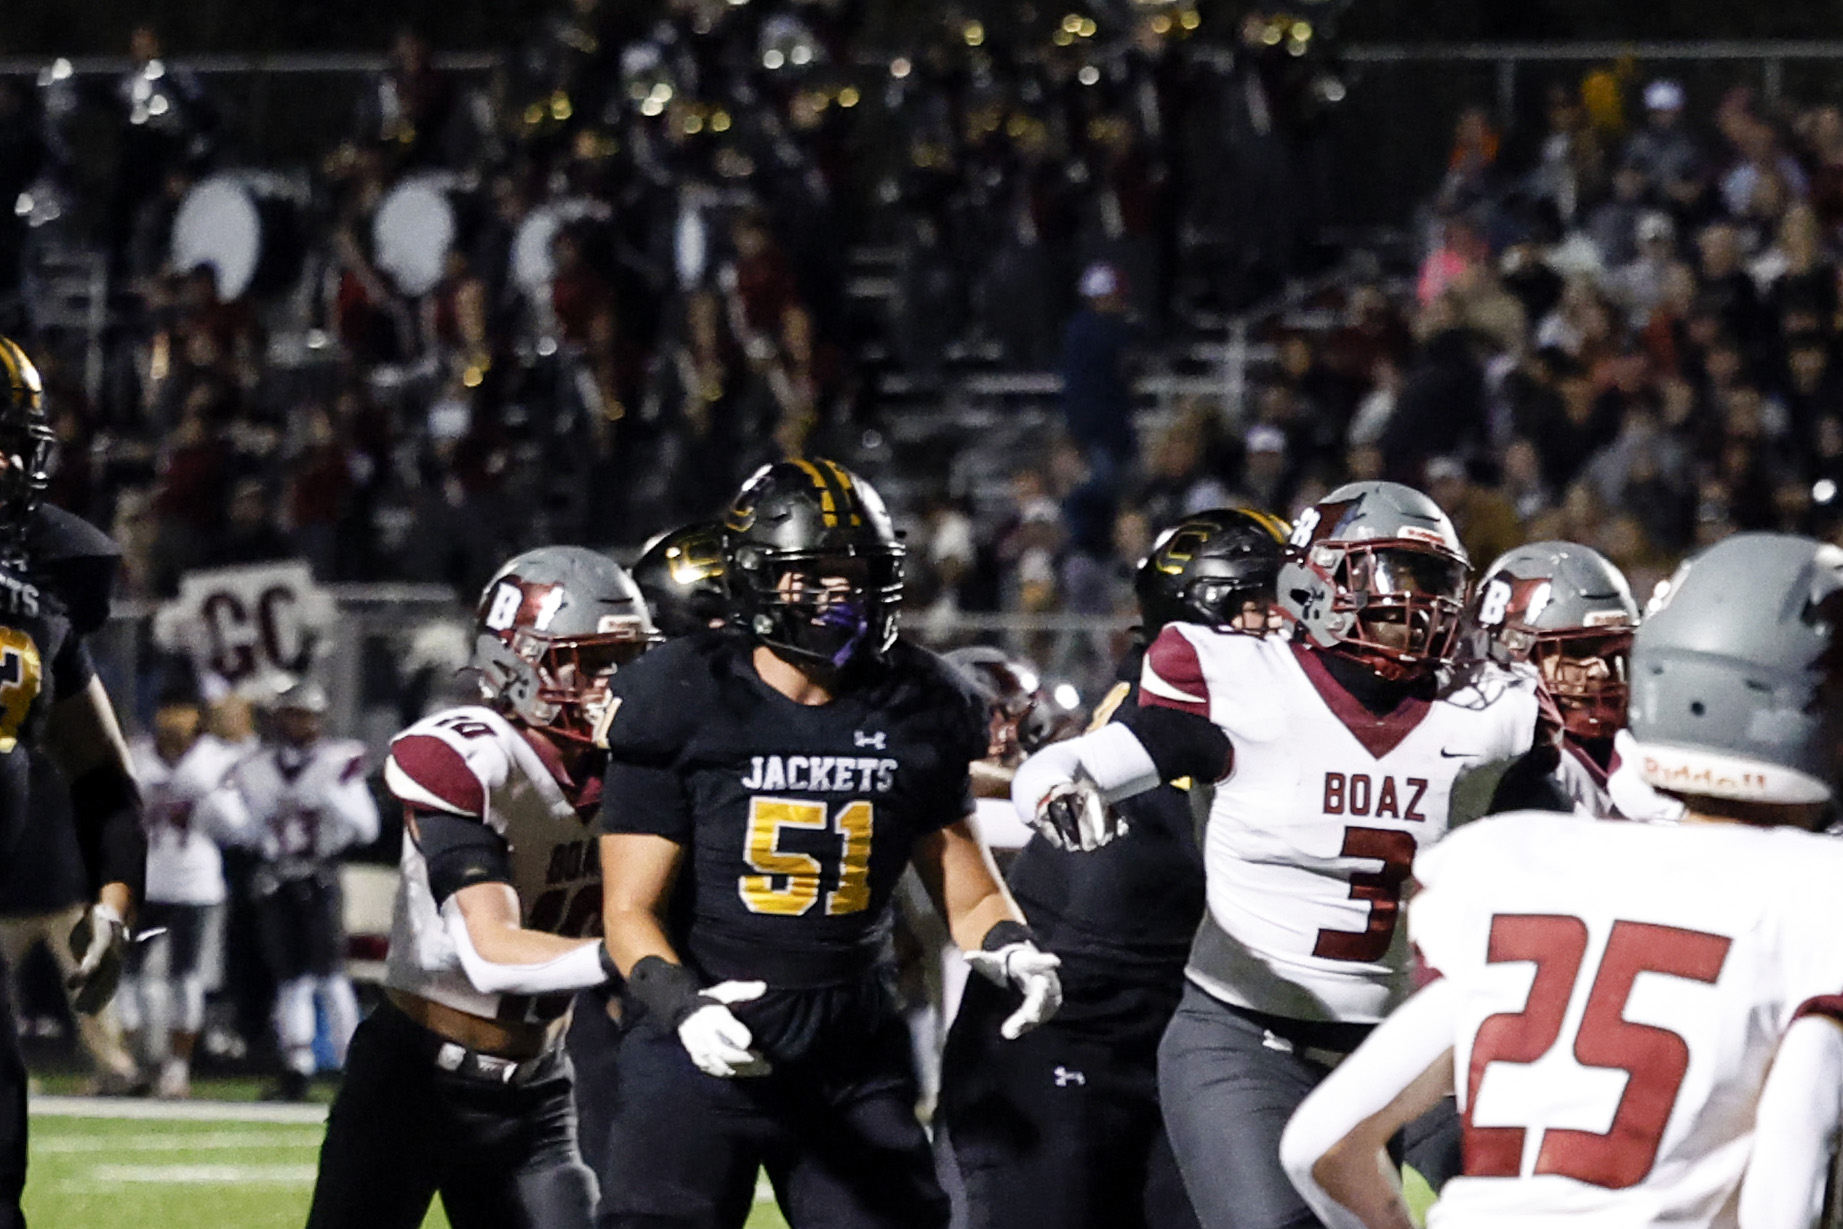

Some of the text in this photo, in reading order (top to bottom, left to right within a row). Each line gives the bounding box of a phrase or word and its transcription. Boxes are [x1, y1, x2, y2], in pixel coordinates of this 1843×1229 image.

[486, 582, 522, 631] B
[1478, 579, 1512, 625] B
[741, 755, 898, 792] JACKETS
[1323, 771, 1429, 822] BOAZ
[738, 795, 874, 917] 51
[1311, 826, 1417, 962] 3
[1462, 912, 1733, 1191] 25
